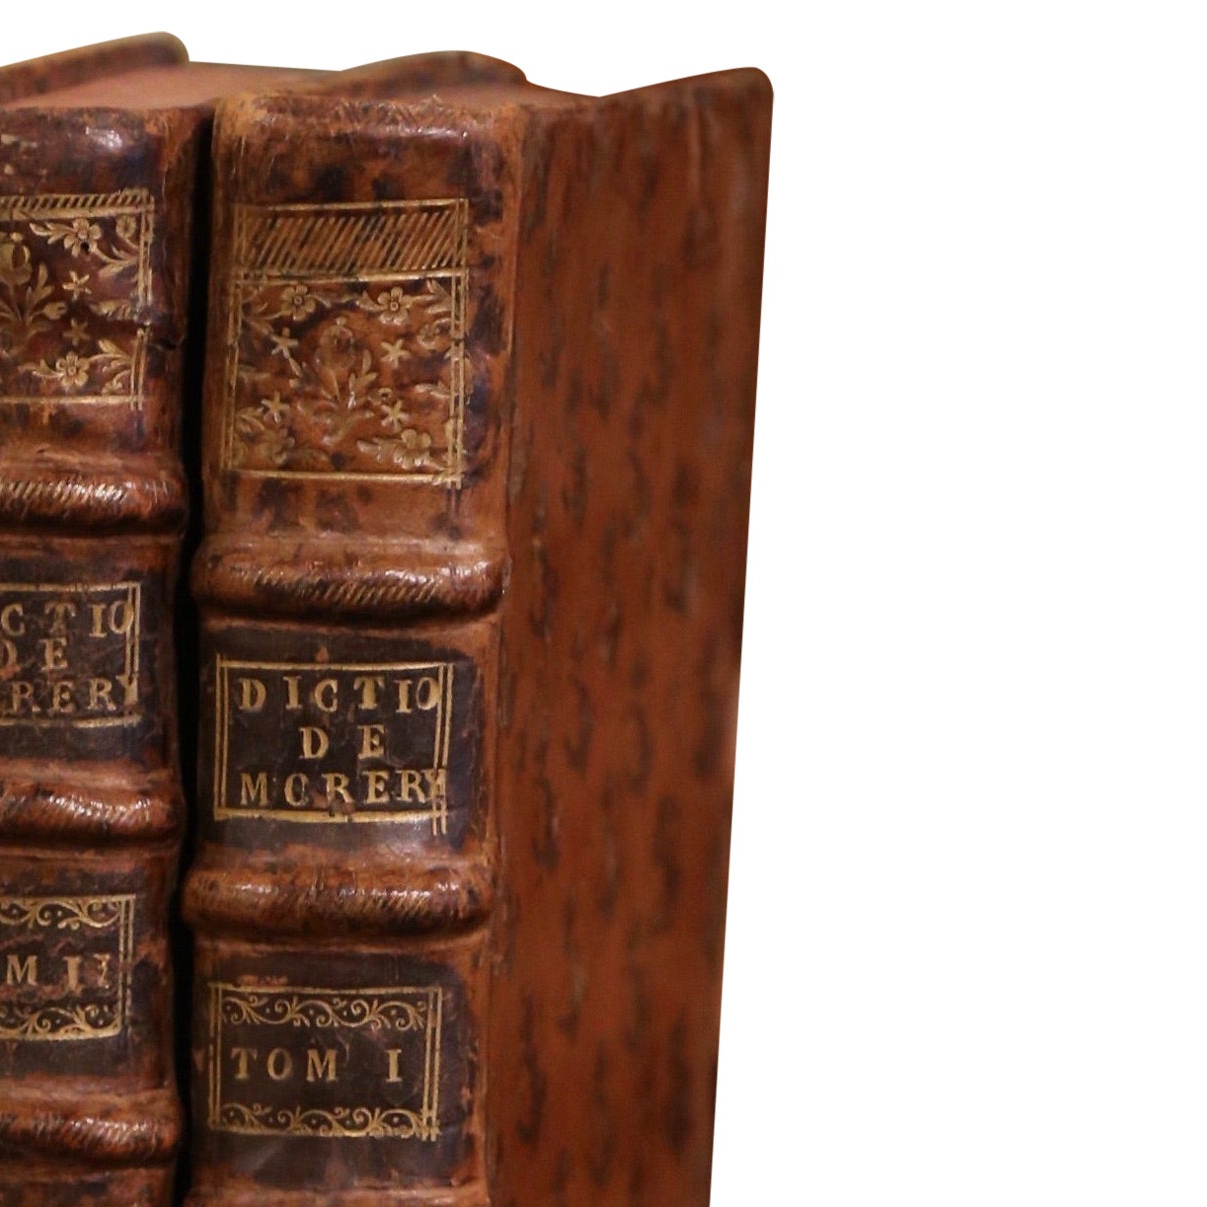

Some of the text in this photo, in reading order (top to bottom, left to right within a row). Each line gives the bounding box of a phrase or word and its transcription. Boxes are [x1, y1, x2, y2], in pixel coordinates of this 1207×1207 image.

[239, 675, 441, 713] DICTIO
[299, 724, 386, 760] DE
[240, 768, 448, 807] MORERY
[230, 1047, 403, 1083] TOM I
